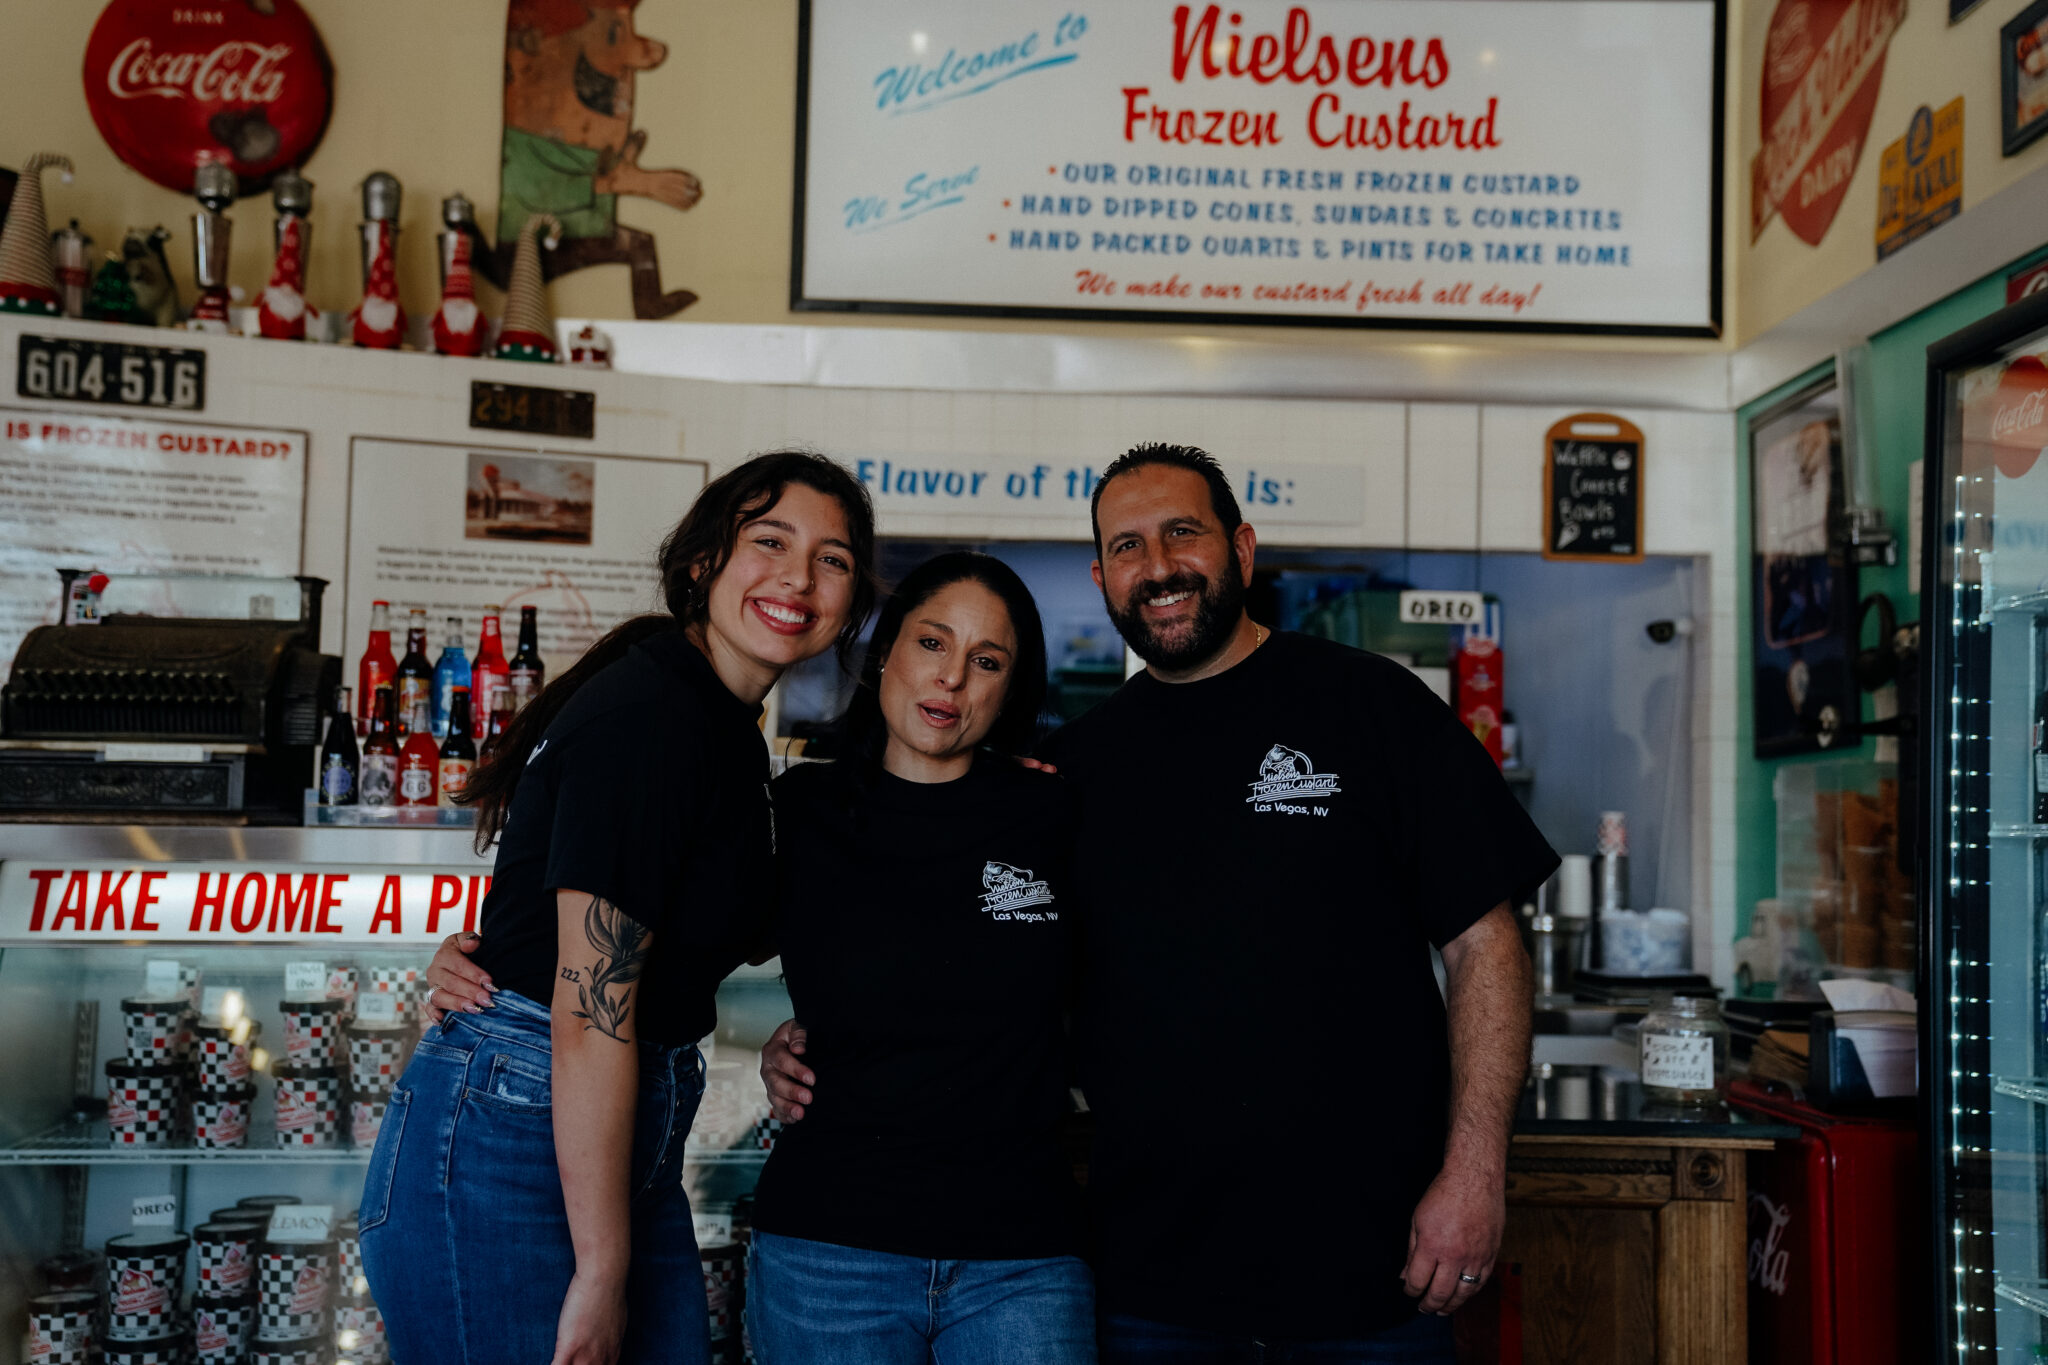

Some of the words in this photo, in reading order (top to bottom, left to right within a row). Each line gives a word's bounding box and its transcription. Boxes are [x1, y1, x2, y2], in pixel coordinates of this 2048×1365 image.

[172, 8, 224, 24] DRINK
[874, 32, 1040, 110] Welcome
[1053, 12, 1090, 47] to
[1171, 3, 1451, 88] Nielsens
[1122, 87, 1283, 147] Frozen
[1307, 92, 1502, 150] Custard
[843, 197, 889, 229] We
[899, 165, 981, 210] Serve
[1064, 163, 1116, 185] OUR
[1127, 165, 1251, 189] ORIGINAL
[1262, 169, 1343, 191] FRESH
[1355, 172, 1453, 193] FROZEN
[1463, 174, 1581, 195] CUSTARD
[1021, 194, 1092, 217] HAND
[1104, 197, 1198, 221] DIPPED
[1312, 204, 1431, 228] SUNDAES
[1444, 206, 1461, 228] &
[1472, 208, 1622, 231] CONCRETES
[1009, 230, 1080, 251] HAND
[1092, 232, 1192, 254] PACKED
[1203, 235, 1300, 259] QUARTS
[1313, 238, 1330, 259] &
[1342, 240, 1413, 261] PINTS
[1425, 241, 1474, 263] FOR
[1485, 242, 1544, 264] TAKE
[1556, 244, 1632, 267] HOME
[1075, 270, 1115, 296] We
[1126, 274, 1192, 299] make
[1200, 283, 1242, 300] our
[1253, 280, 1352, 302] custard
[1356, 279, 1423, 313] fresh
[1433, 282, 1470, 306] all
[1480, 284, 1540, 313] day!
[8, 421, 30, 439] IS
[42, 424, 147, 449] FROZEN
[158, 432, 291, 459] CUSTARD?
[855, 459, 988, 498] Flavor
[1004, 464, 1051, 499] of
[1246, 471, 1295, 506] is:
[1410, 600, 1473, 619] OREO
[1252, 781, 1293, 800] Frozen
[1254, 802, 1272, 812] Las
[1274, 802, 1311, 816] Vegas,
[1313, 806, 1330, 817] NV
[28, 870, 167, 932] TAKE
[188, 872, 350, 933] HOME
[369, 875, 402, 934] A
[992, 911, 1011, 921] Las
[1012, 911, 1046, 923] Vegas,
[1046, 912, 1059, 921] NV
[560, 967, 580, 983] 222
[132, 1202, 175, 1216] OREO
[270, 1214, 332, 1230] LEMON
[1748, 1191, 1792, 1297] ola
